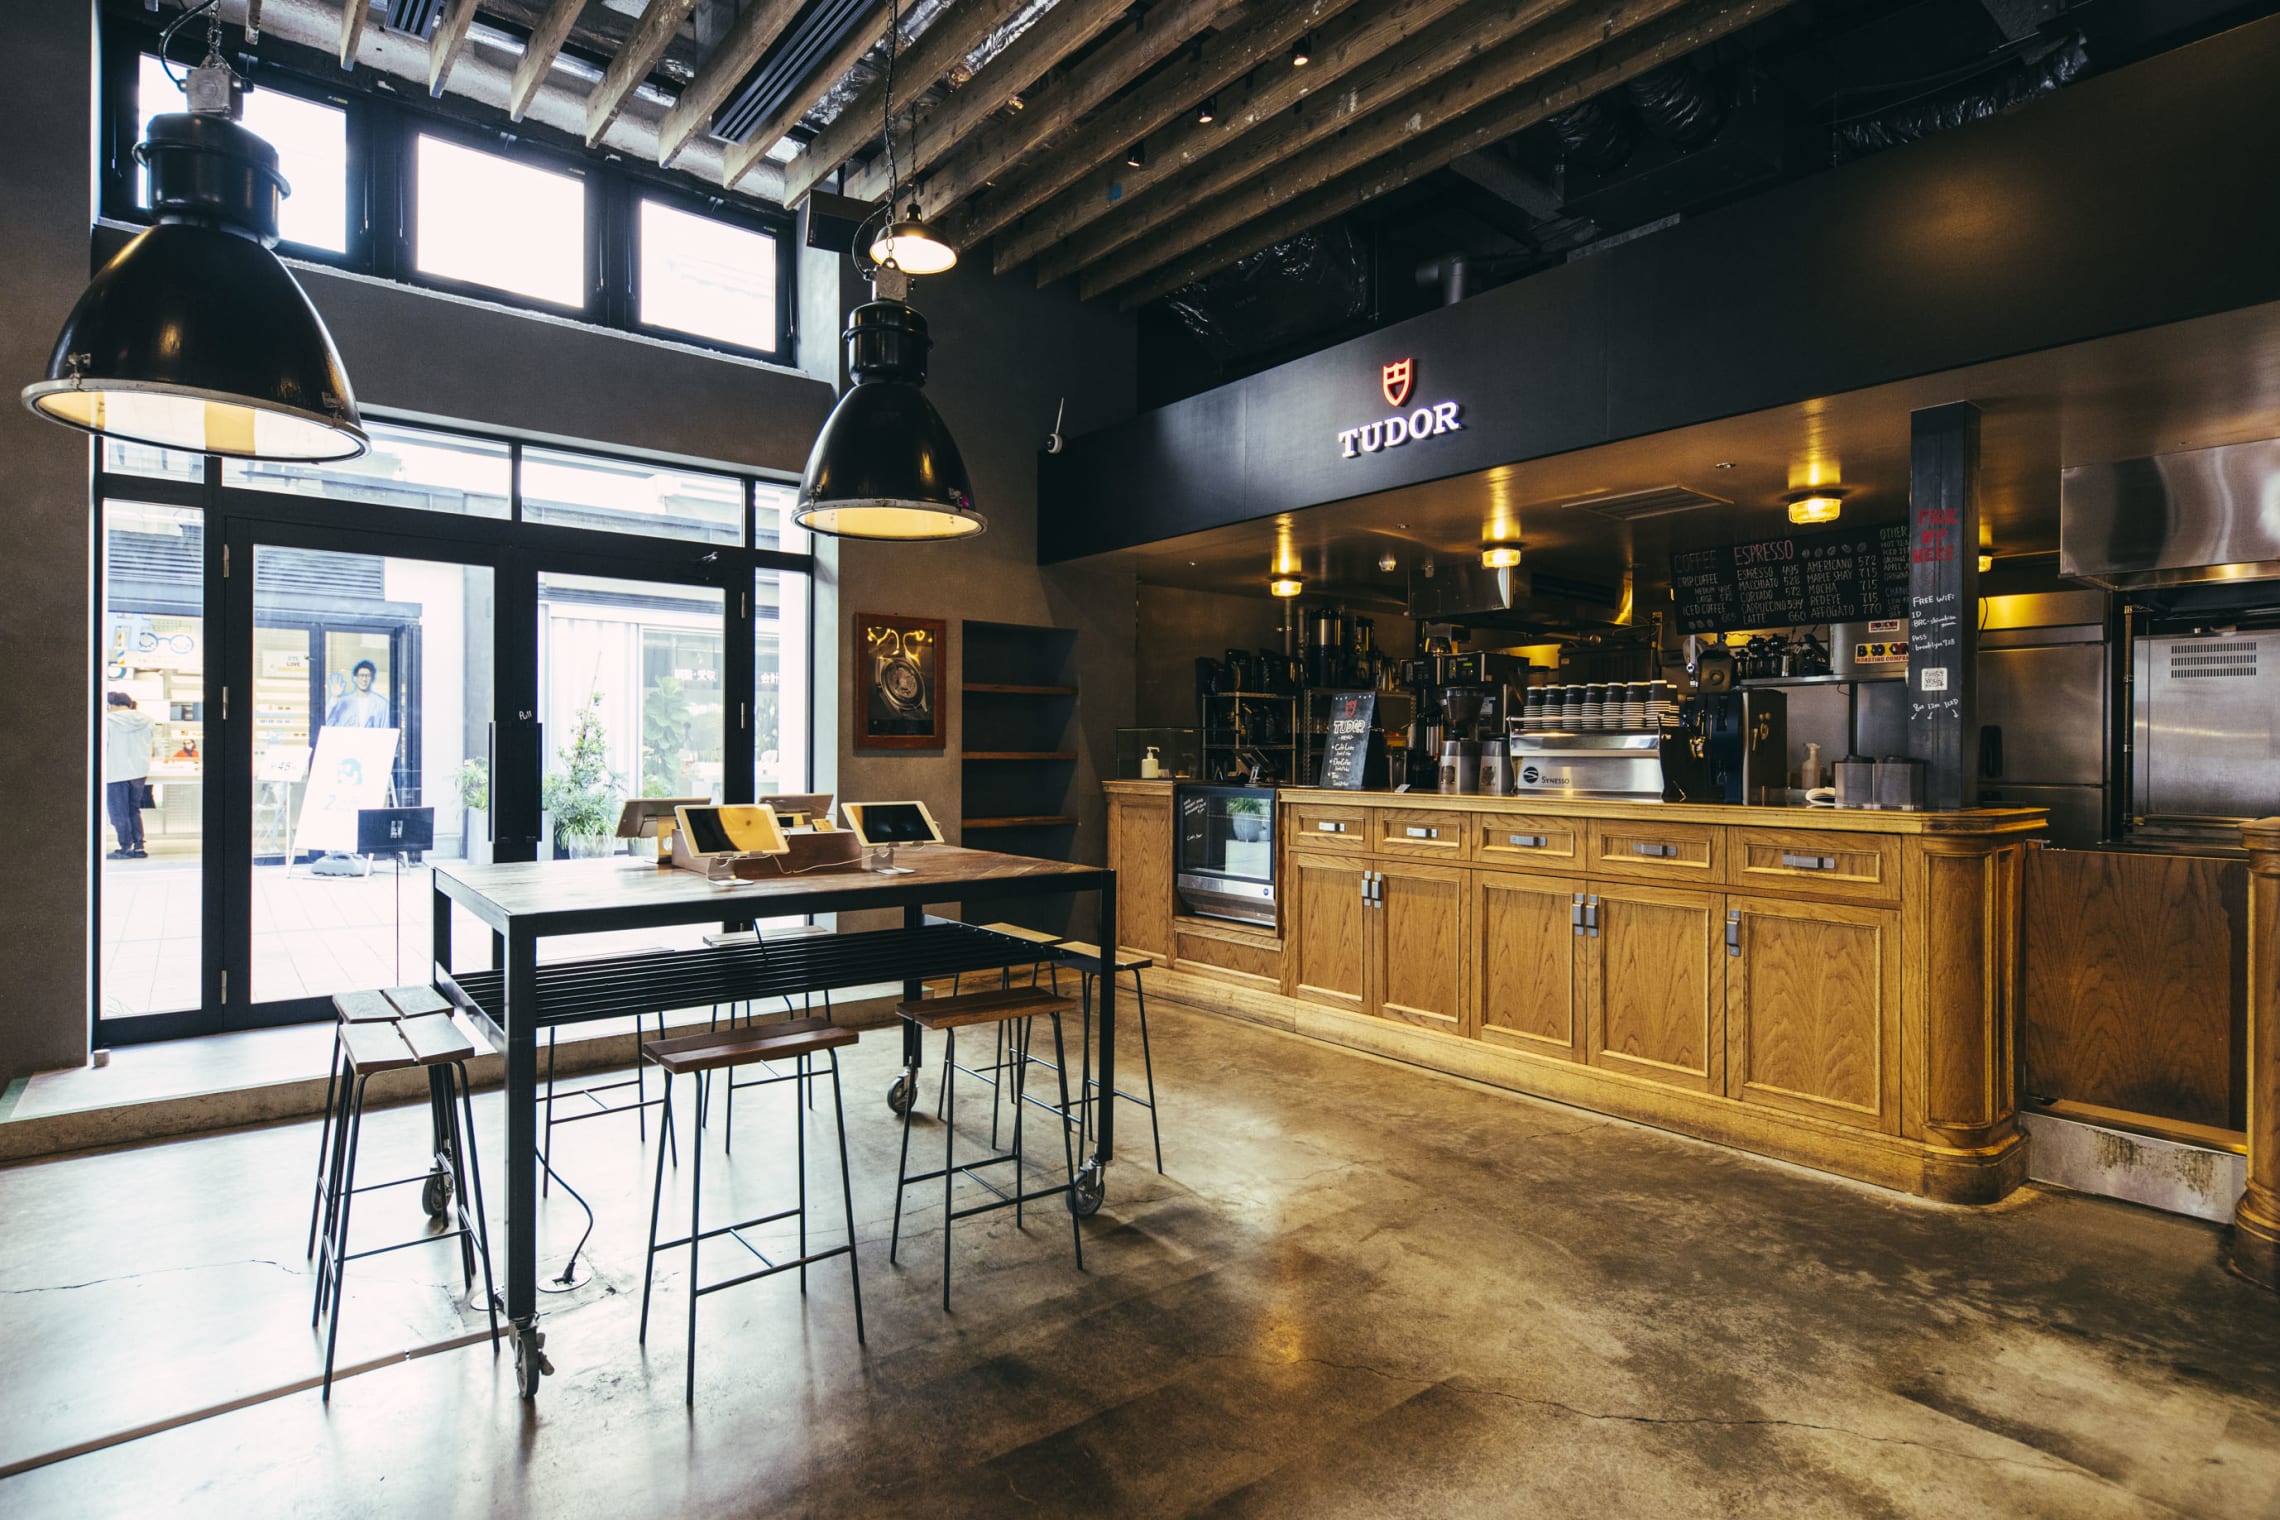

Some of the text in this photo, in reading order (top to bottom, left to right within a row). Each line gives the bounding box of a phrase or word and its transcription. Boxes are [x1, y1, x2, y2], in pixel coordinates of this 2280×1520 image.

[1338, 401, 1461, 458] TUDOR
[1918, 507, 1958, 527] PICK
[1922, 528, 1949, 545] UP
[1734, 539, 1794, 566] ESPRESSO
[1913, 545, 1956, 564] HERE
[1807, 554, 1878, 573] AMERICANO 572
[1737, 566, 1773, 581] ESPRESSO
[1807, 572, 1831, 585] MAPLE
[1859, 566, 1878, 578] 715
[1738, 578, 1779, 592] MACCHIATO
[1808, 579, 1880, 595] MOCHA 715
[1740, 589, 1773, 603] CORTADO
[1859, 592, 1878, 604] 715
[1912, 595, 1934, 608] FREE
[1682, 602, 1727, 617] ICED COFFEE
[1741, 599, 1787, 615] CAPPUCCINO
[1810, 603, 1882, 618] AFFOGATO 770
[1911, 610, 1922, 619] ID
[1743, 613, 1767, 625] LATTE
[1334, 719, 1365, 734] TUDOR
